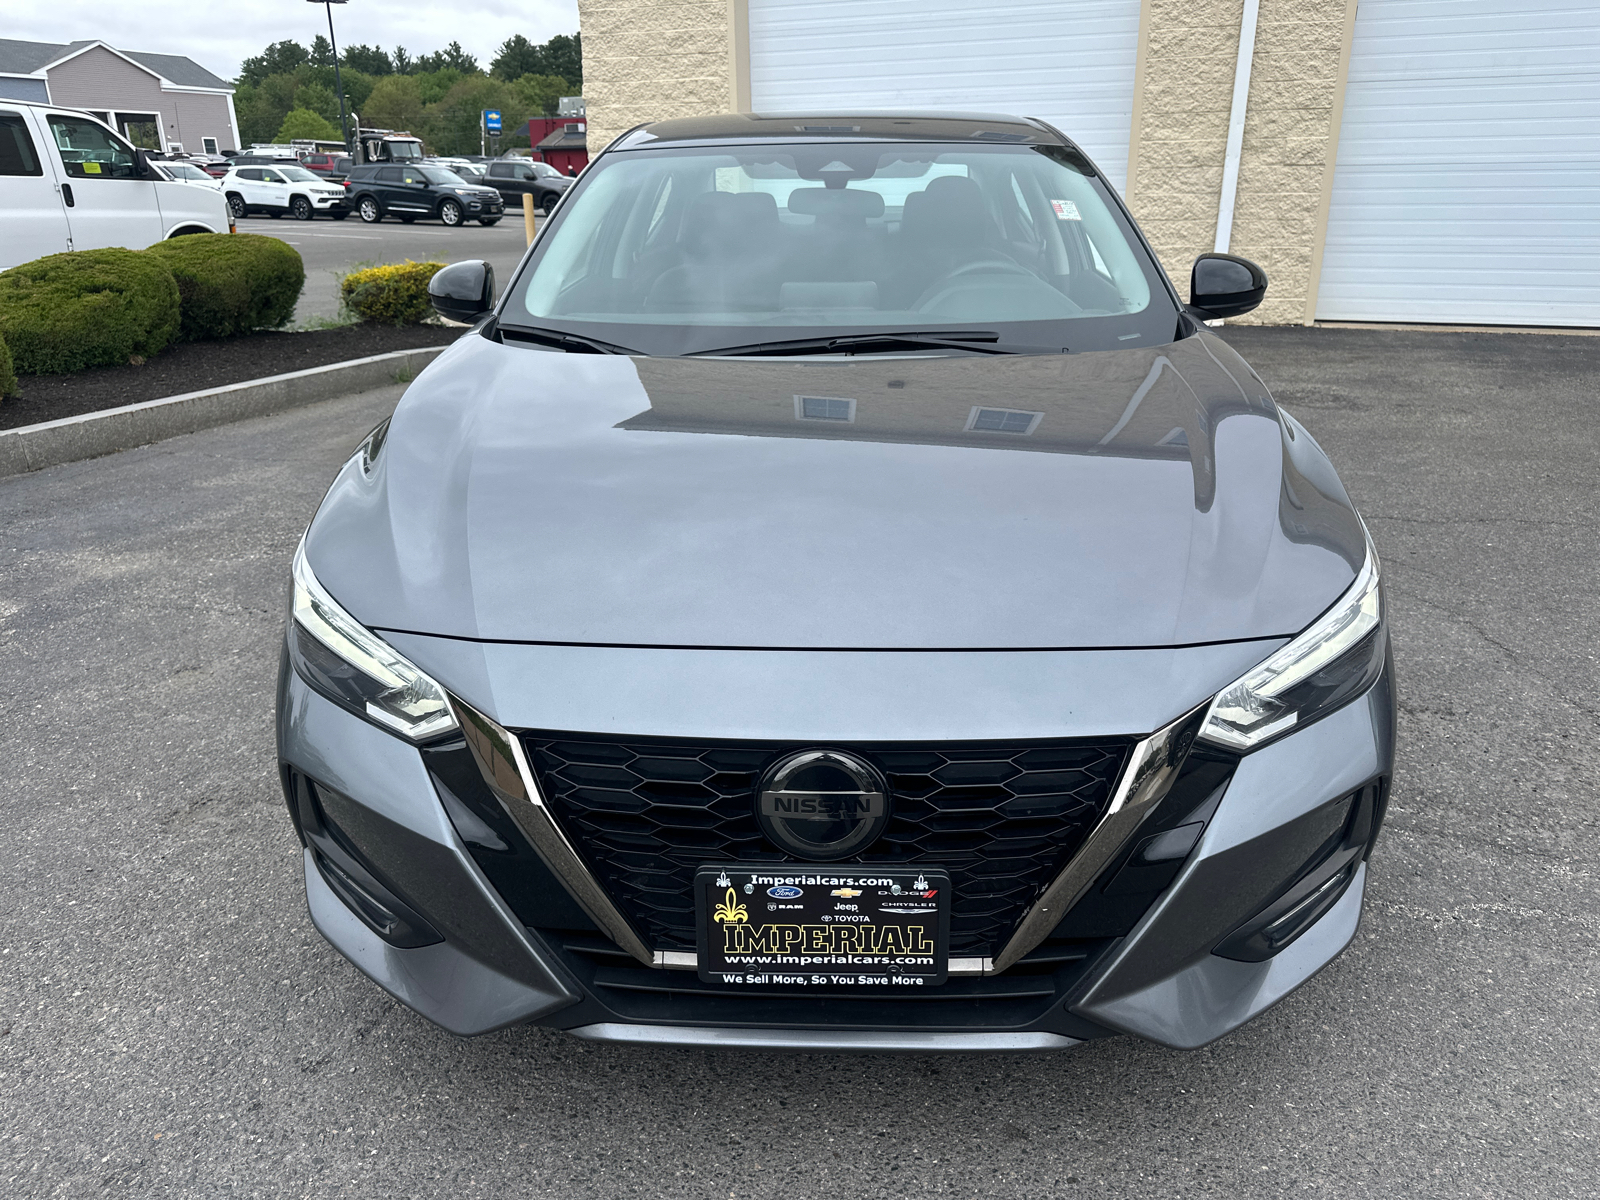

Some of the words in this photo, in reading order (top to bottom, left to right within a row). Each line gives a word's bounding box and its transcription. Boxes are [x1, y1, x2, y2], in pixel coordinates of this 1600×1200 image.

[774, 798, 870, 813] NISSAN
[751, 875, 893, 887] Imperialcars.com
[774, 888, 795, 897] Ford
[834, 902, 858, 912] Jeep
[723, 924, 934, 955] IMPERIAL
[724, 954, 934, 965] www.imperialcars.com
[723, 974, 744, 984] We
[746, 974, 769, 984] Sell
[772, 974, 807, 986] More,
[811, 975, 828, 984] So
[830, 975, 856, 984] You
[858, 975, 889, 985] Save
[892, 975, 924, 985] More
